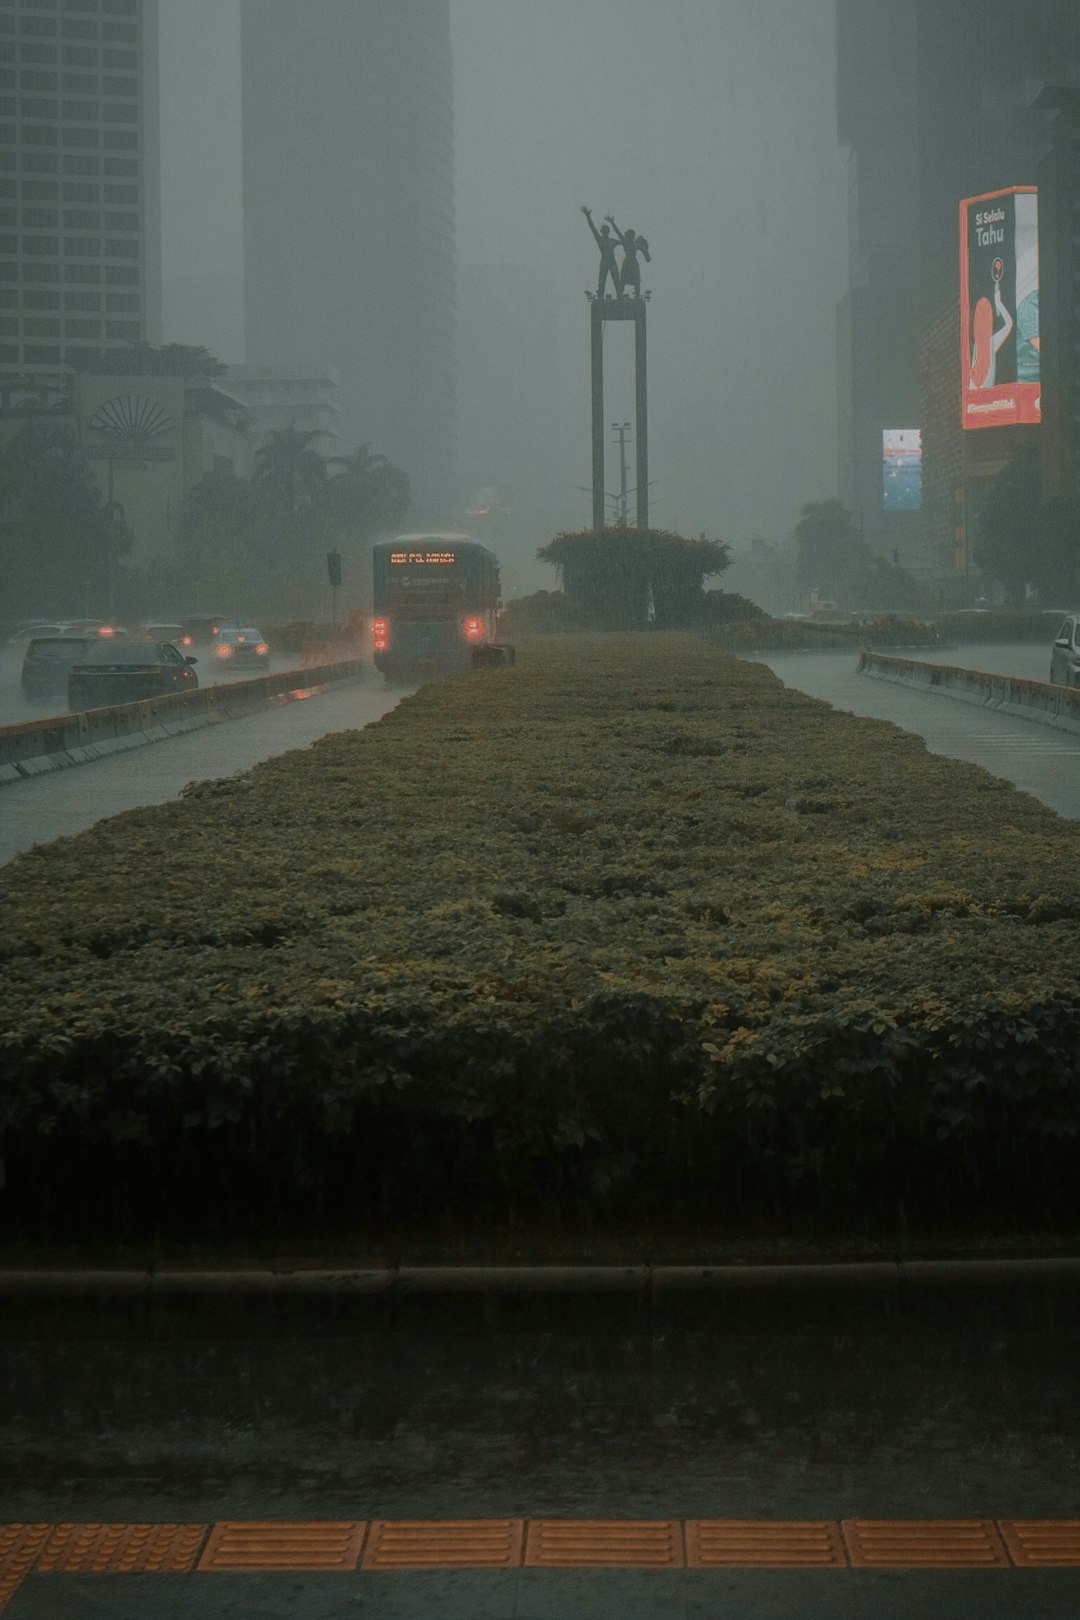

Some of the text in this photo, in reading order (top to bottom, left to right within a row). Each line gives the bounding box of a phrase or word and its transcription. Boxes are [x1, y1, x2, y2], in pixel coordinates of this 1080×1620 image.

[975, 208, 1005, 225] Si Selalu
[976, 224, 1003, 247] Tahu
